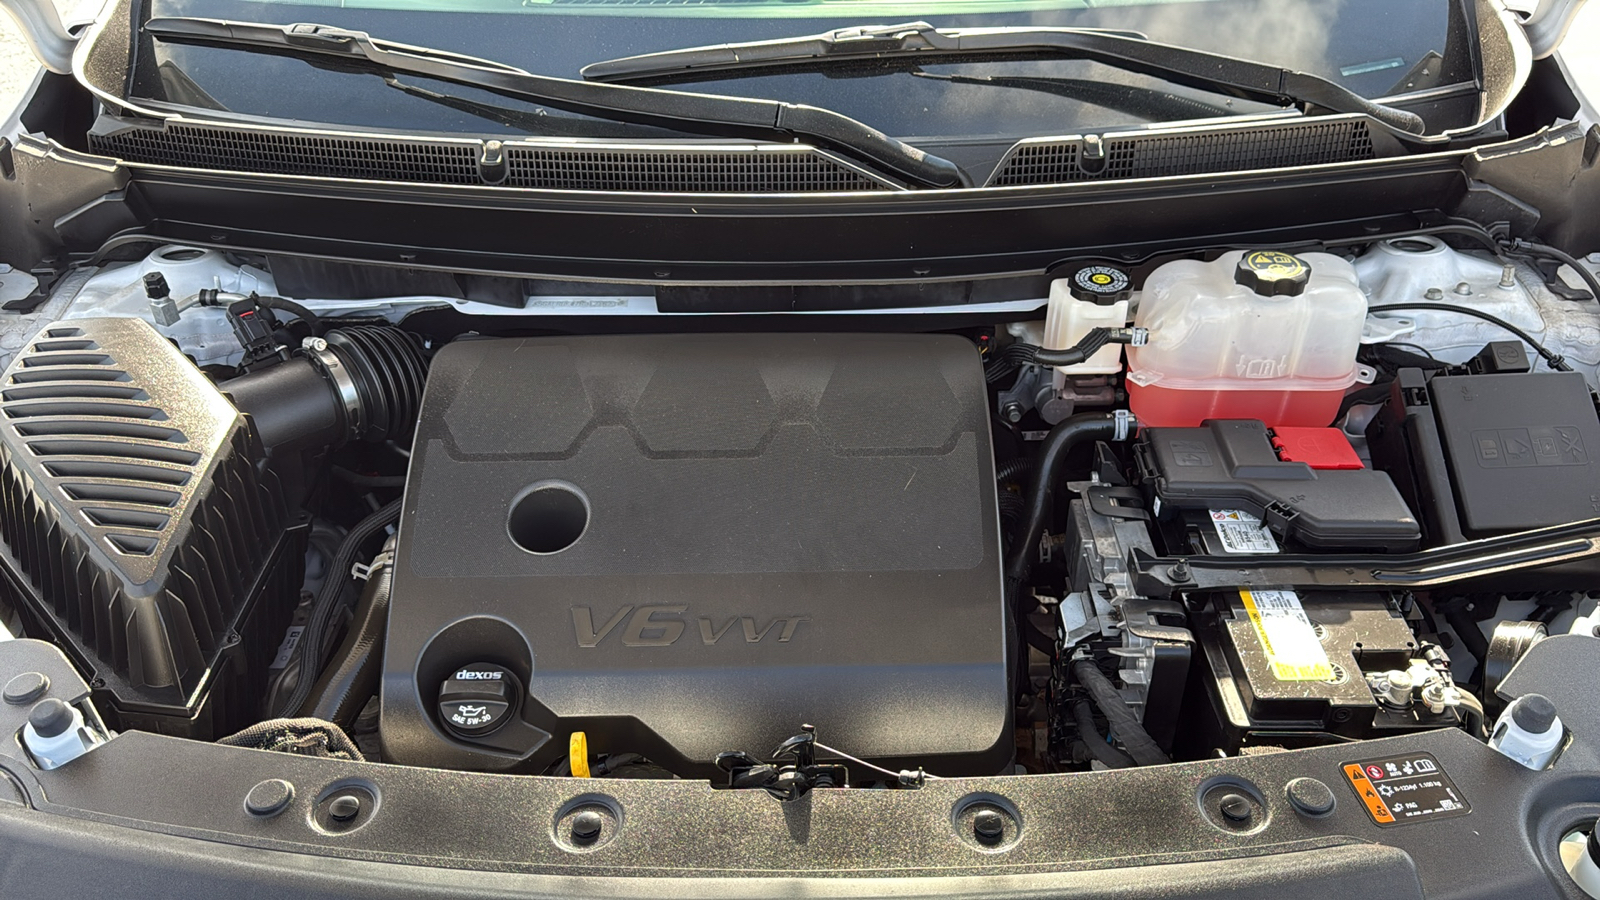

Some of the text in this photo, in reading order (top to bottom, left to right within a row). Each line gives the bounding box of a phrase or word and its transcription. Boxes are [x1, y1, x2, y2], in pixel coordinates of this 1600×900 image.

[571, 604, 812, 647] V6 VVT
[456, 669, 504, 680] dexos
[451, 713, 492, 726] SAE 5W-30
